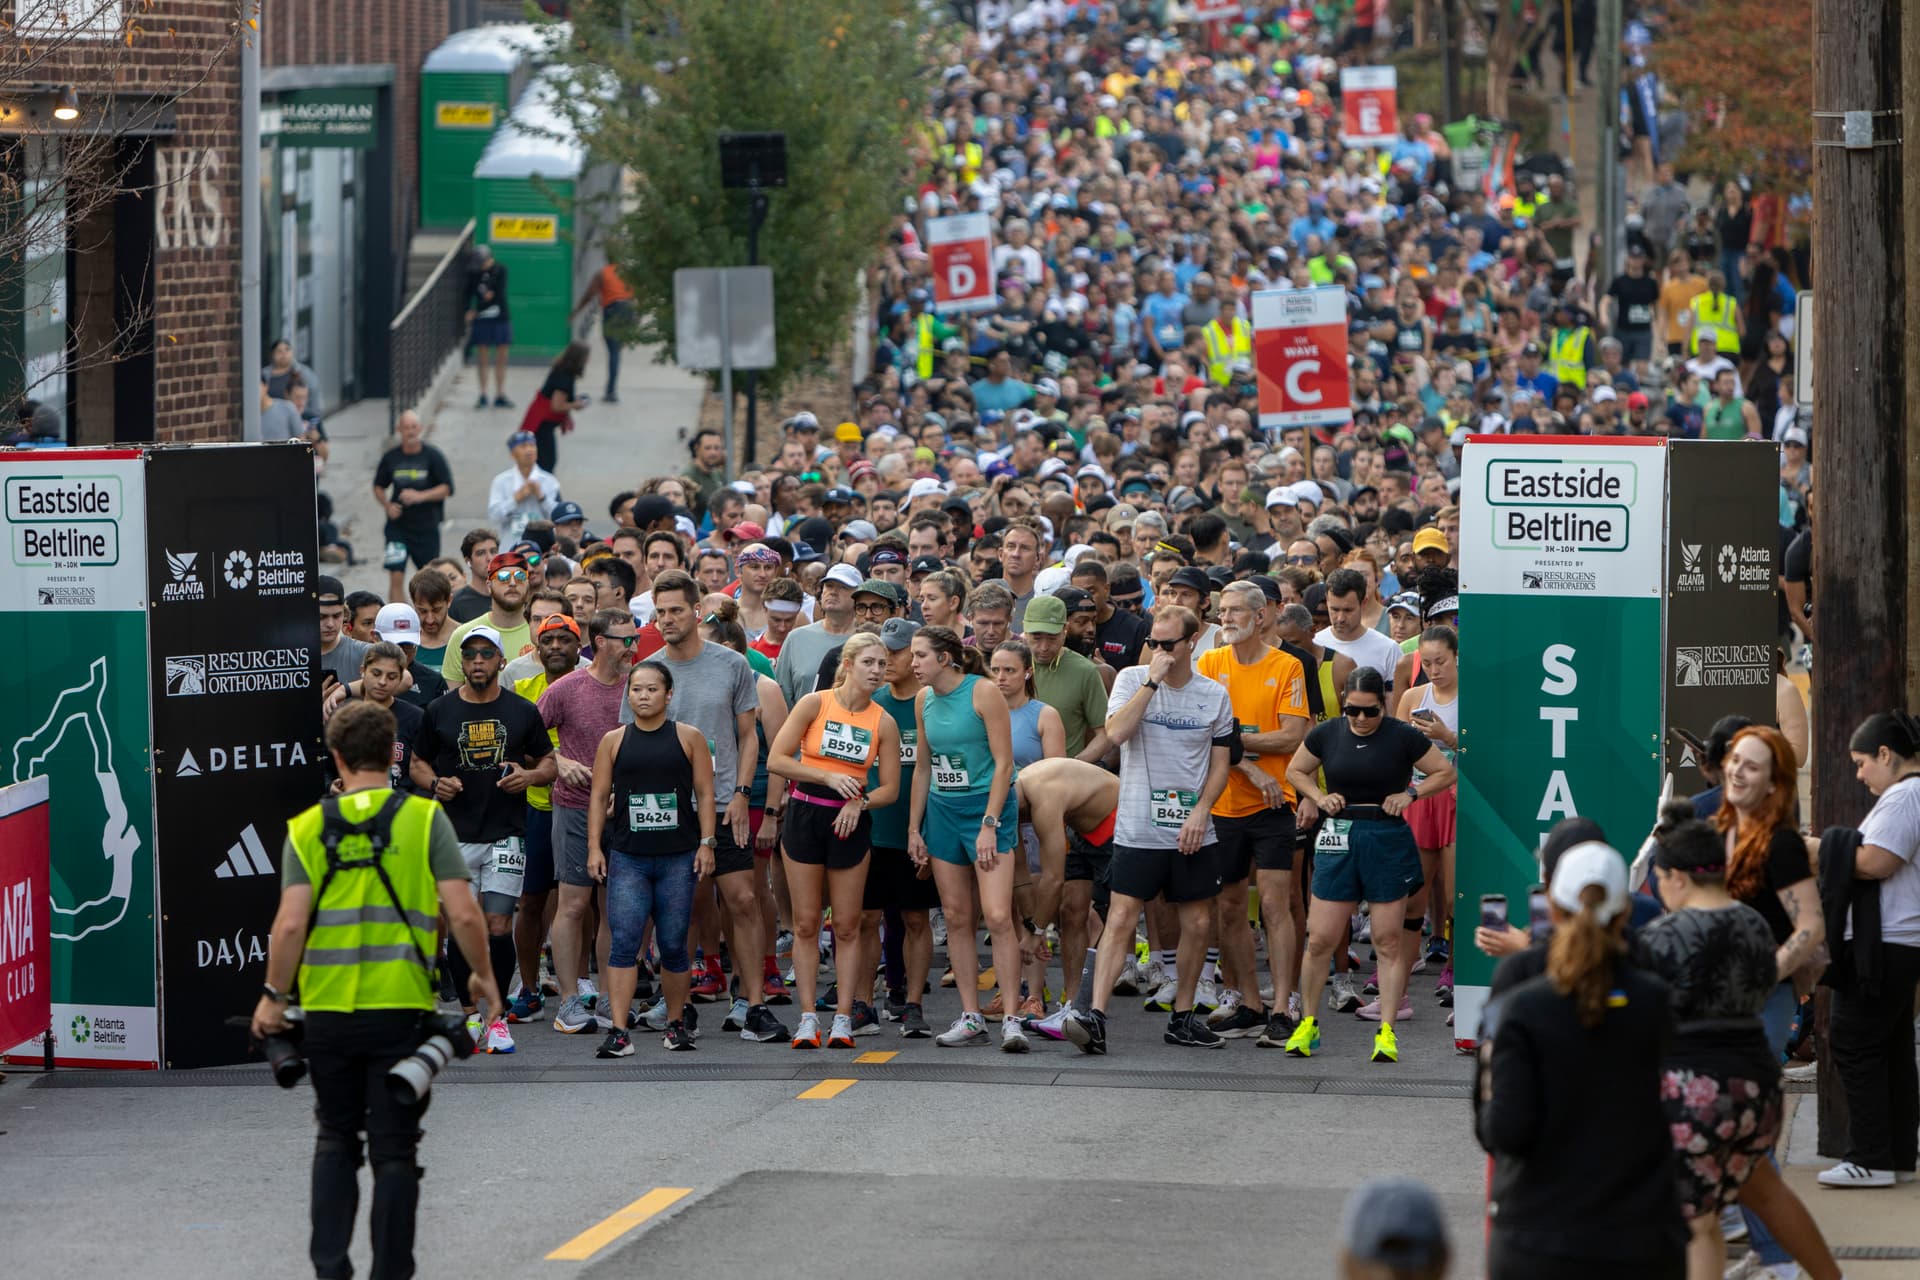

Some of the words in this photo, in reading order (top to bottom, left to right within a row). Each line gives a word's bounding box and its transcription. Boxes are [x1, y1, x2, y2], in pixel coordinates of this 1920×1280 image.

[948, 264, 977, 295] D
[1284, 345, 1319, 358] WAVE
[1285, 360, 1323, 405] C
[1504, 467, 1620, 498] Eastside
[19, 482, 110, 514] Eastside
[1508, 512, 1612, 542] Beltline
[24, 528, 105, 557] Beltline
[258, 550, 304, 567] Atlanta
[1740, 546, 1770, 562] Atlanta
[258, 568, 305, 586] Beltline
[1544, 572, 1596, 581] RESURGENS
[1677, 574, 1705, 586] ATLANTA
[1740, 565, 1770, 581] Beltline
[55, 587, 95, 595] RESURGENS
[162, 582, 204, 595] ATLANTA
[258, 587, 305, 596] PARTNERSHIP
[1544, 581, 1596, 590] ORTHOPAEDICS
[55, 597, 95, 605] ORTHOPAEDICS
[208, 648, 309, 671] RESURGENS
[1704, 645, 1770, 663] RESURGENS
[208, 671, 310, 694] ORTHOPAEDICS
[1704, 668, 1770, 686] ORTHOPAEDICS
[827, 722, 839, 732] 10K
[828, 738, 863, 755] B599
[209, 742, 307, 772] DELTA
[1536, 643, 1579, 884] STA
[937, 772, 963, 783] B585
[631, 797, 644, 805] 10K
[636, 812, 672, 823] B424
[1157, 807, 1191, 820] B425
[197, 927, 273, 973] DASA
[7, 961, 35, 1004] CLUB
[94, 1017, 125, 1030] Atlanta
[94, 1030, 126, 1044] Beltline
